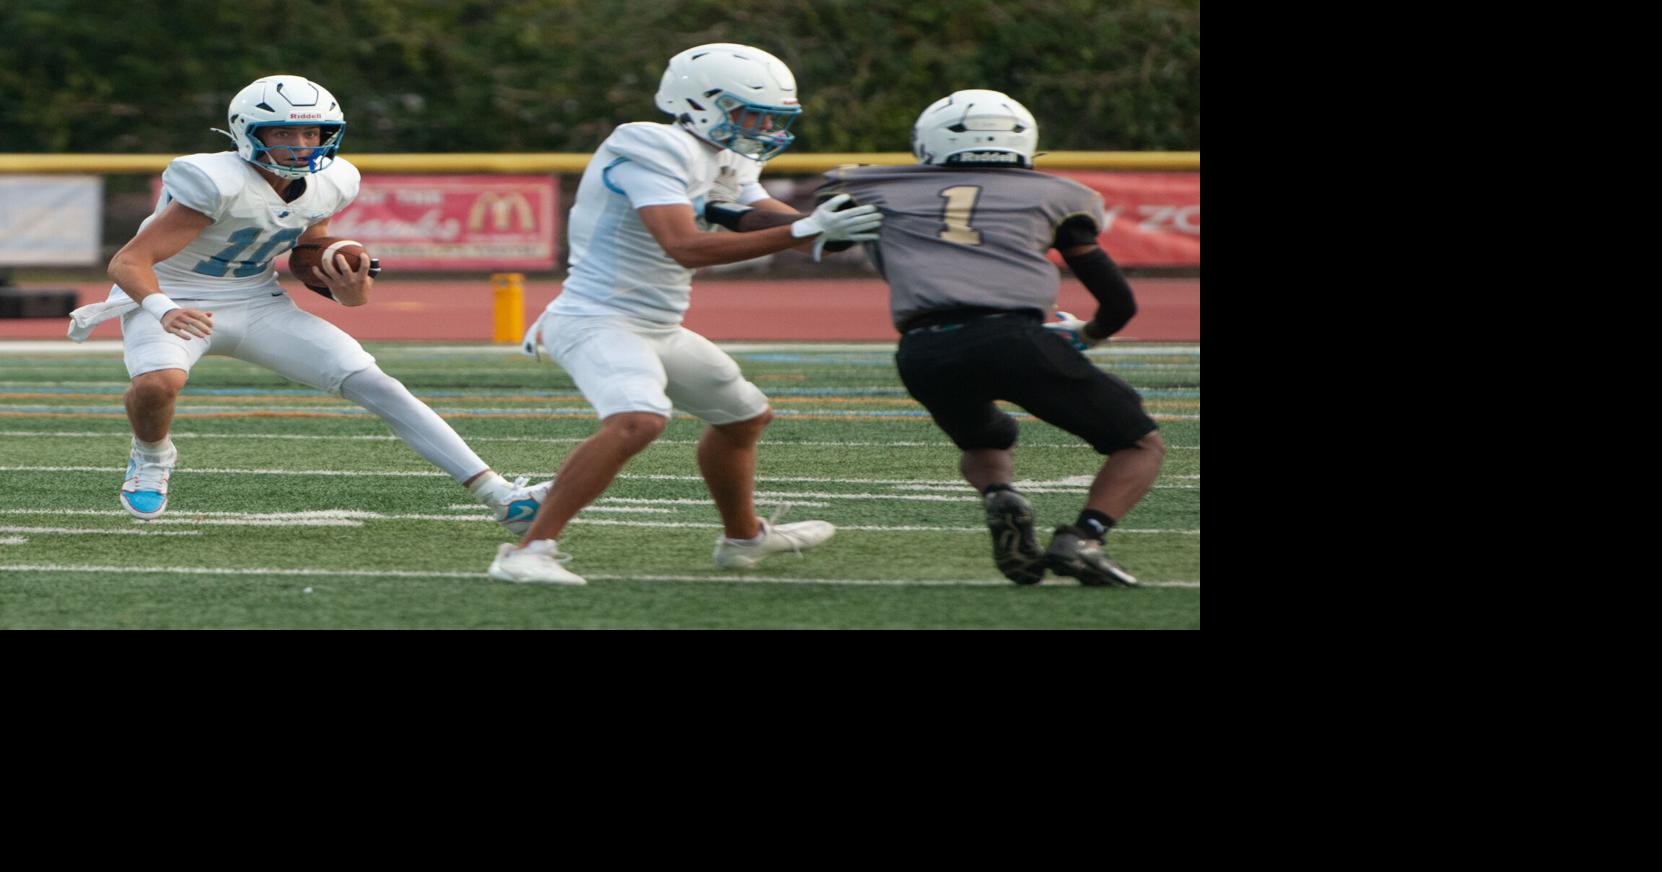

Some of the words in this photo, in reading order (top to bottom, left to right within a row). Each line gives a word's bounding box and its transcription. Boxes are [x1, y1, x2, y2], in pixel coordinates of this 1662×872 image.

[289, 112, 322, 120] Riddell
[961, 151, 1018, 162] Riddell
[940, 186, 982, 245] 1
